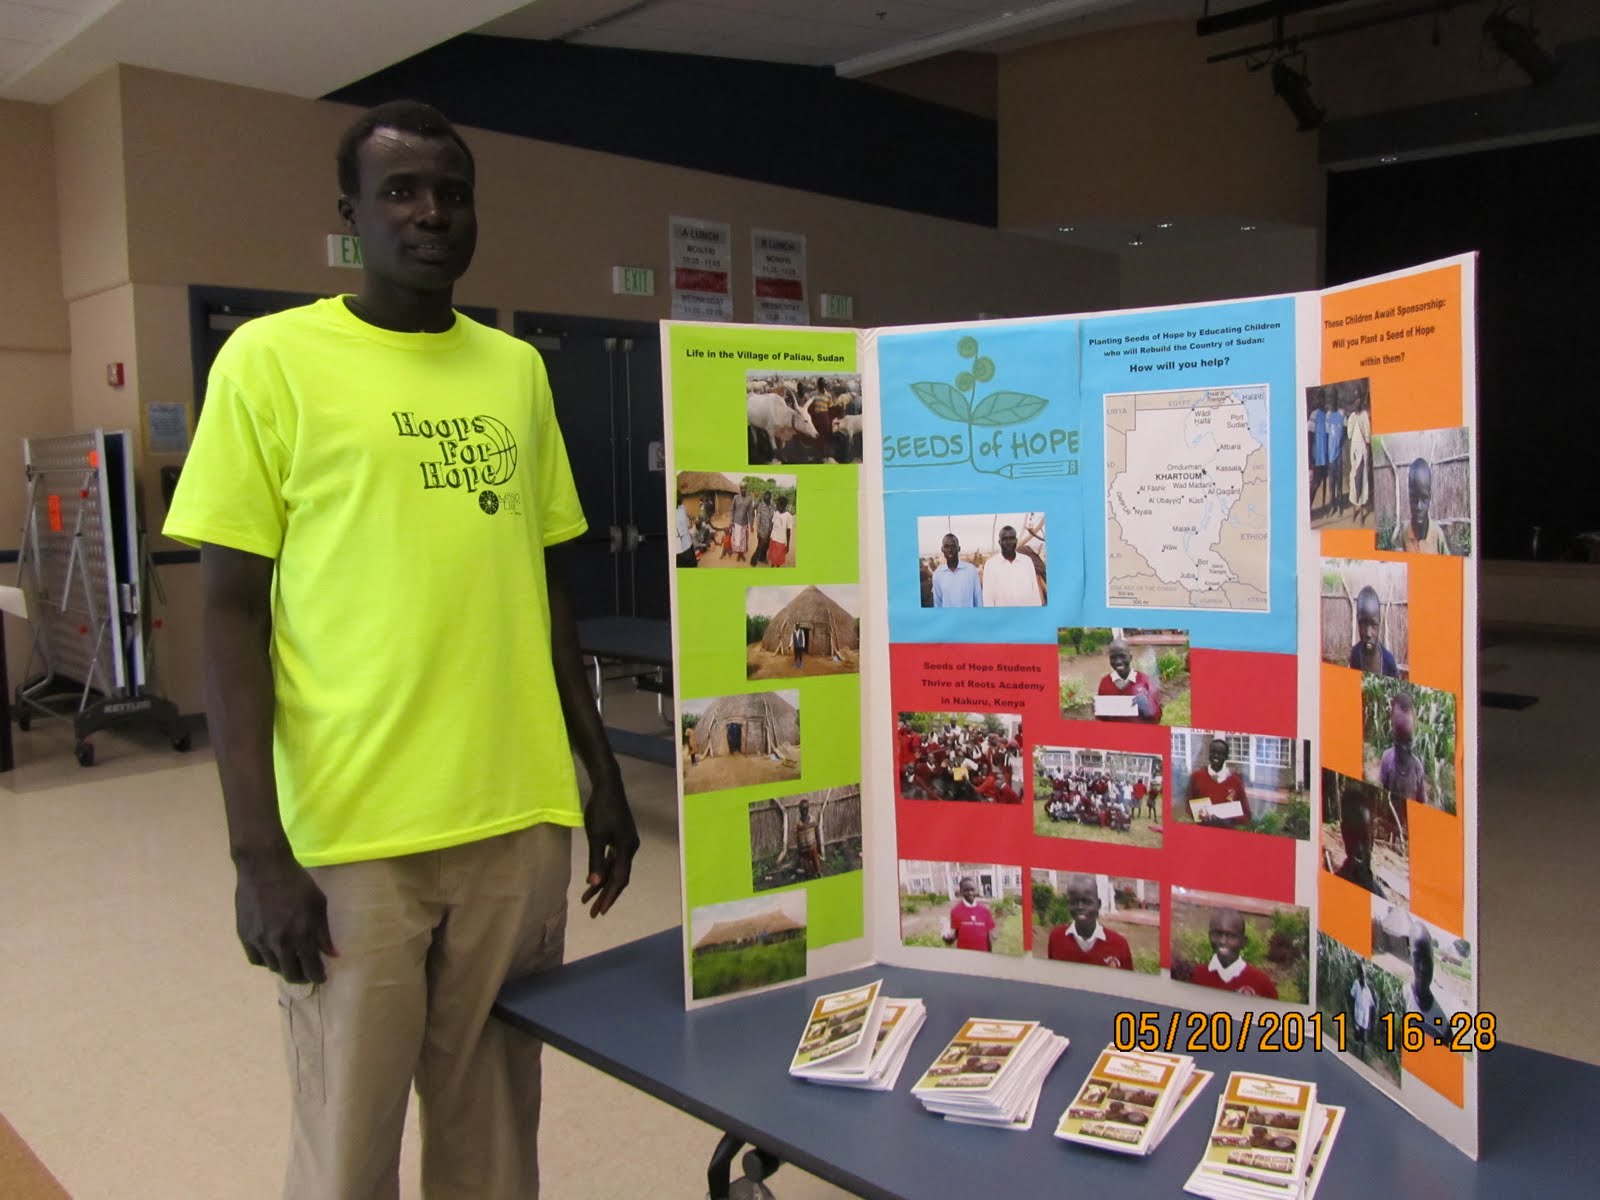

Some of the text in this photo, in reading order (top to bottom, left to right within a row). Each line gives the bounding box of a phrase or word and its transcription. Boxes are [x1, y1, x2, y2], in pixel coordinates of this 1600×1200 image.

[682, 228, 719, 240] A LUNCH
[341, 236, 361, 264] EX
[624, 269, 648, 292] EXIT
[680, 294, 724, 305] WEDNESDAY
[760, 302, 800, 311] WEDNESDAY
[830, 295, 848, 314] EXIT
[1324, 298, 1446, 329] These Children Await Sponsorship:
[1089, 322, 1281, 346] Planting Seeds of Hope by Educating Children
[1332, 339, 1345, 349] Will
[1346, 339, 1359, 349] you
[1360, 334, 1378, 344] Plant
[1386, 330, 1404, 341] Seed
[1406, 326, 1414, 337] of
[1415, 325, 1436, 337] Hope
[686, 349, 844, 362] Life in the Village of Paliau, Sudan
[1104, 349, 1120, 357] who
[1140, 345, 1171, 354] Rebuild
[1190, 340, 1223, 351] Country
[1236, 336, 1265, 346] Sudan:
[1130, 356, 1230, 372] How will you help?
[1360, 352, 1406, 367] within them?
[392, 411, 486, 442] Hoops
[438, 440, 492, 466] For
[882, 429, 1079, 462] SEEDS of HOPE
[420, 461, 496, 493] Hope
[1156, 472, 1202, 480] KHARTOUM
[1116, 492, 1131, 516] DARFUR
[924, 662, 1042, 672] Seeds of Hope Students
[921, 679, 1045, 692] Thrive at Roots Academy
[953, 697, 990, 706] Nakuru,
[994, 698, 1025, 708] Kenya
